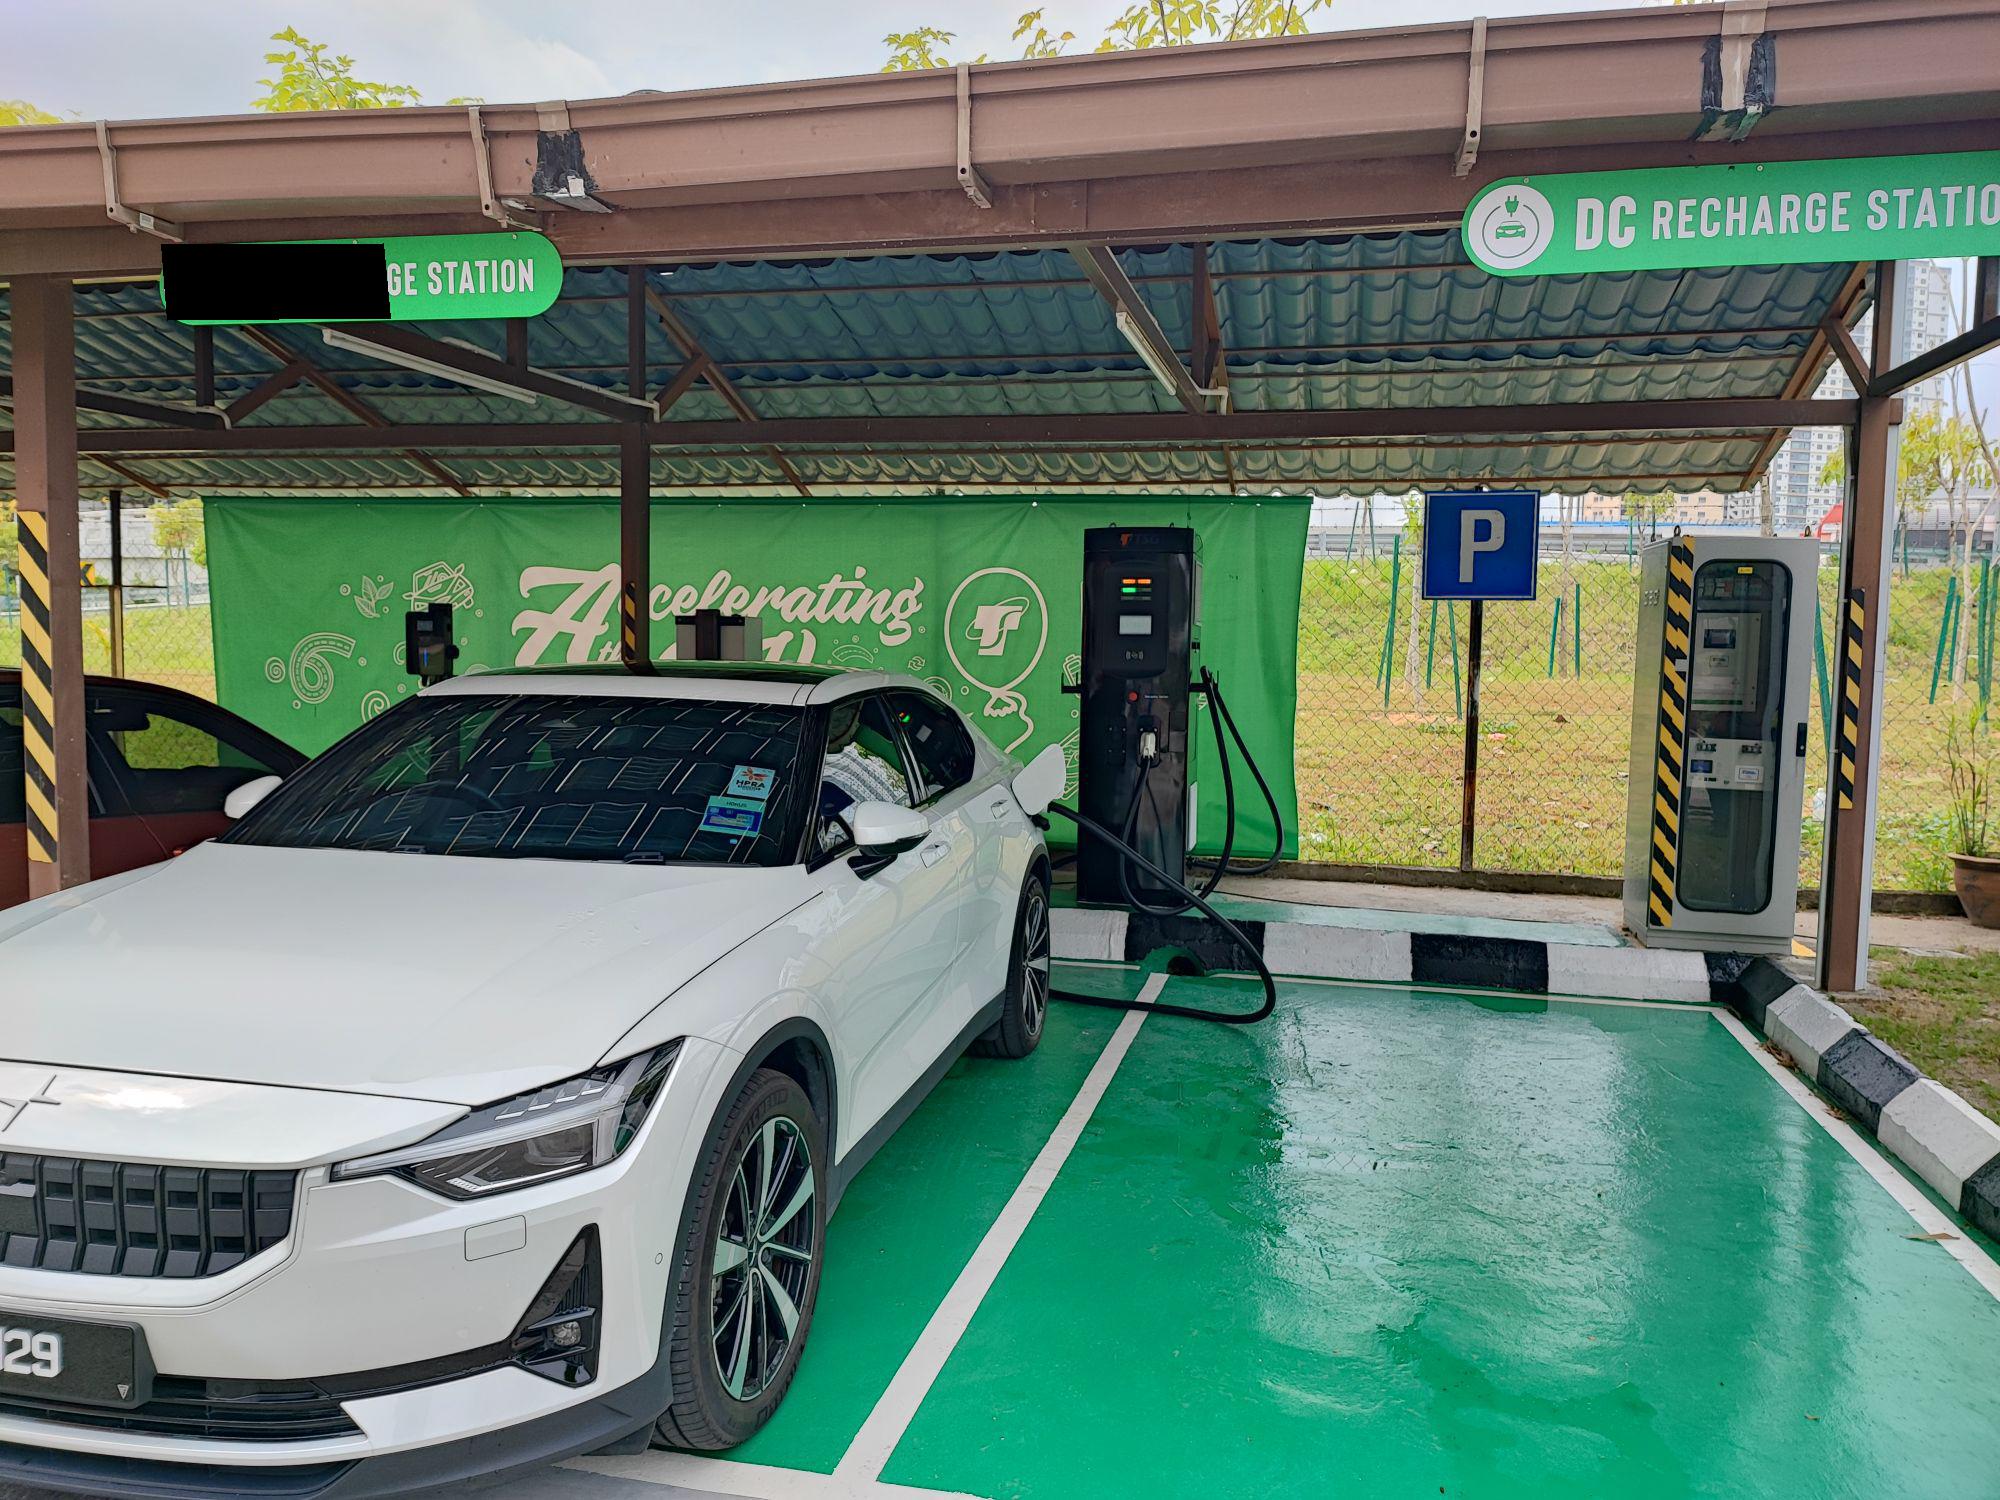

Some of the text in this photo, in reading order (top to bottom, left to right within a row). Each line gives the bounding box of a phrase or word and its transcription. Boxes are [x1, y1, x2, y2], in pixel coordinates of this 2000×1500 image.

[1575, 183, 2000, 251] DC RECHARGE STATIO
[427, 258, 534, 296] STATION
[1459, 509, 1506, 583] P
[511, 562, 924, 668] Acelerating
